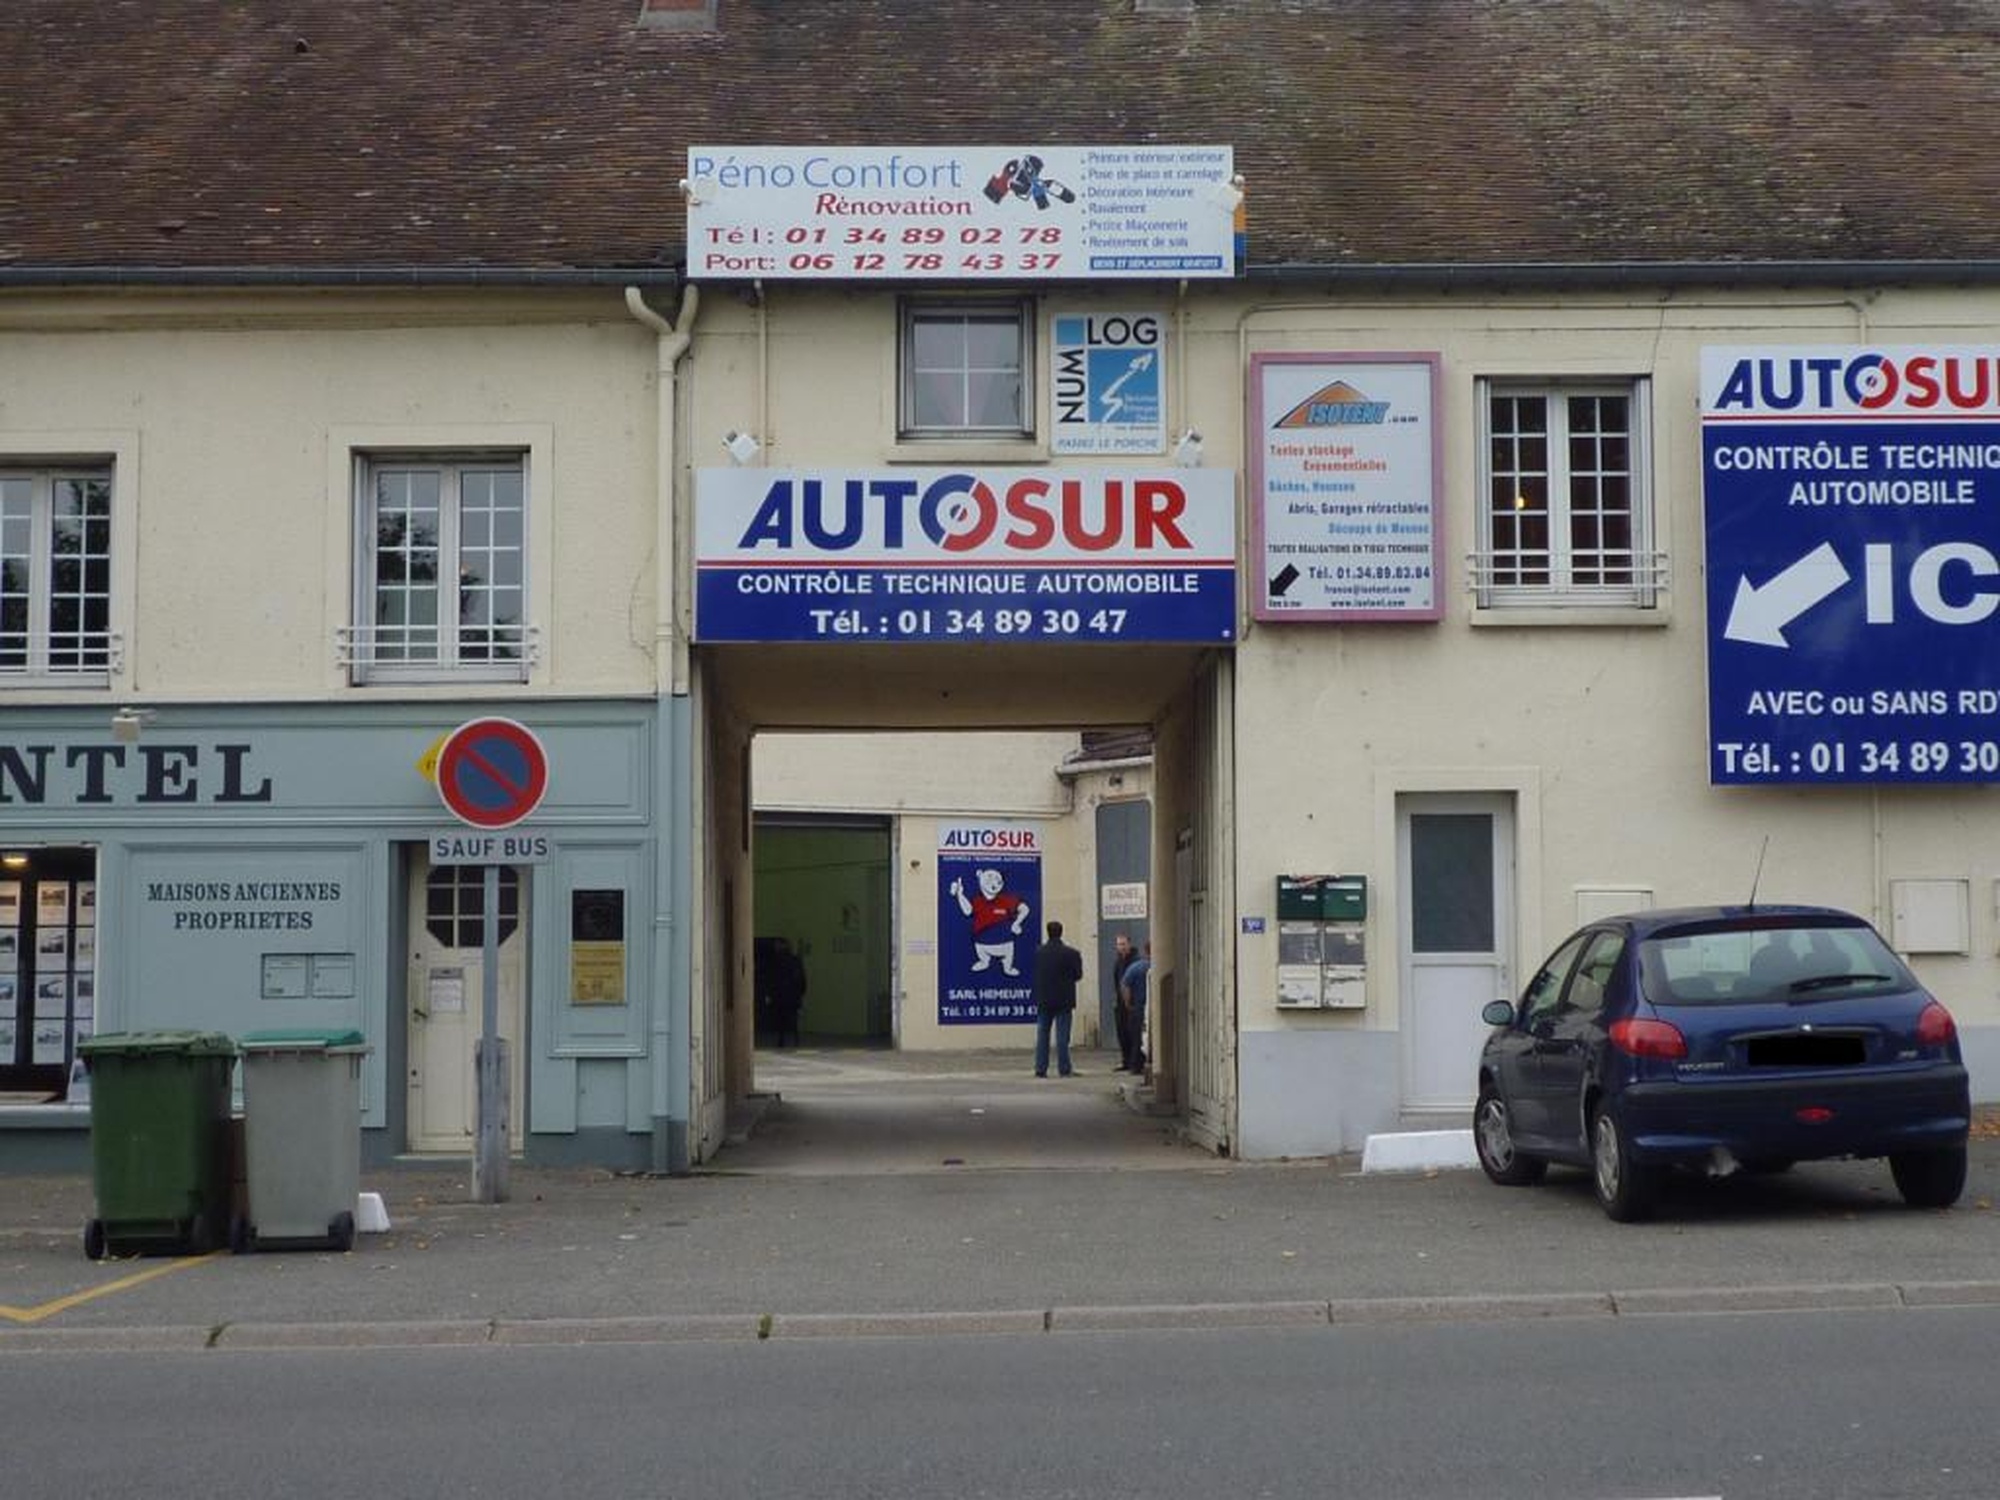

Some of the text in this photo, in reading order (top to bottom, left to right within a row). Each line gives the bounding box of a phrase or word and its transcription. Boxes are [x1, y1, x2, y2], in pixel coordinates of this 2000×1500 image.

[1116, 168, 1130, 180] de
[815, 193, 972, 216] Rénovation
[785, 227, 827, 244] 01
[843, 227, 887, 244] 34
[901, 227, 945, 244] 89
[960, 227, 1003, 245] 02
[1019, 227, 1062, 244] 78
[706, 253, 1062, 271] Port: 06 12 78 43 37
[1087, 316, 1158, 345] LOG
[1056, 349, 1086, 423] NUM
[1713, 353, 2000, 410] AUTOSU
[1713, 440, 1869, 470] CONTRÔLE
[1788, 480, 1976, 505] AUTOMOBILE
[737, 474, 1194, 552] AUTOSUR
[1321, 502, 1363, 517] Garages
[737, 570, 1200, 595] CONTRÔLE TECHNIQUE AUTOMOBILE
[1308, 565, 1333, 580] Tél.
[809, 609, 869, 634] Tél.
[897, 610, 932, 634] 01
[946, 609, 986, 634] 34
[994, 609, 1032, 634] 89
[1042, 609, 1080, 634] 30
[1089, 609, 1127, 634] 47
[1747, 690, 2000, 715] AVEC ou SANS RD
[1717, 742, 1781, 774] Tél.
[1810, 741, 1846, 774] 01
[1860, 741, 1900, 773] 34
[1910, 741, 1950, 773] 89
[1960, 741, 2000, 773] 30
[436, 837, 548, 858] SAUF BUS
[944, 829, 1036, 848] AUTOSUR
[148, 882, 341, 902] MAISONS ANCIENNES
[175, 911, 313, 930] PROPRIETES
